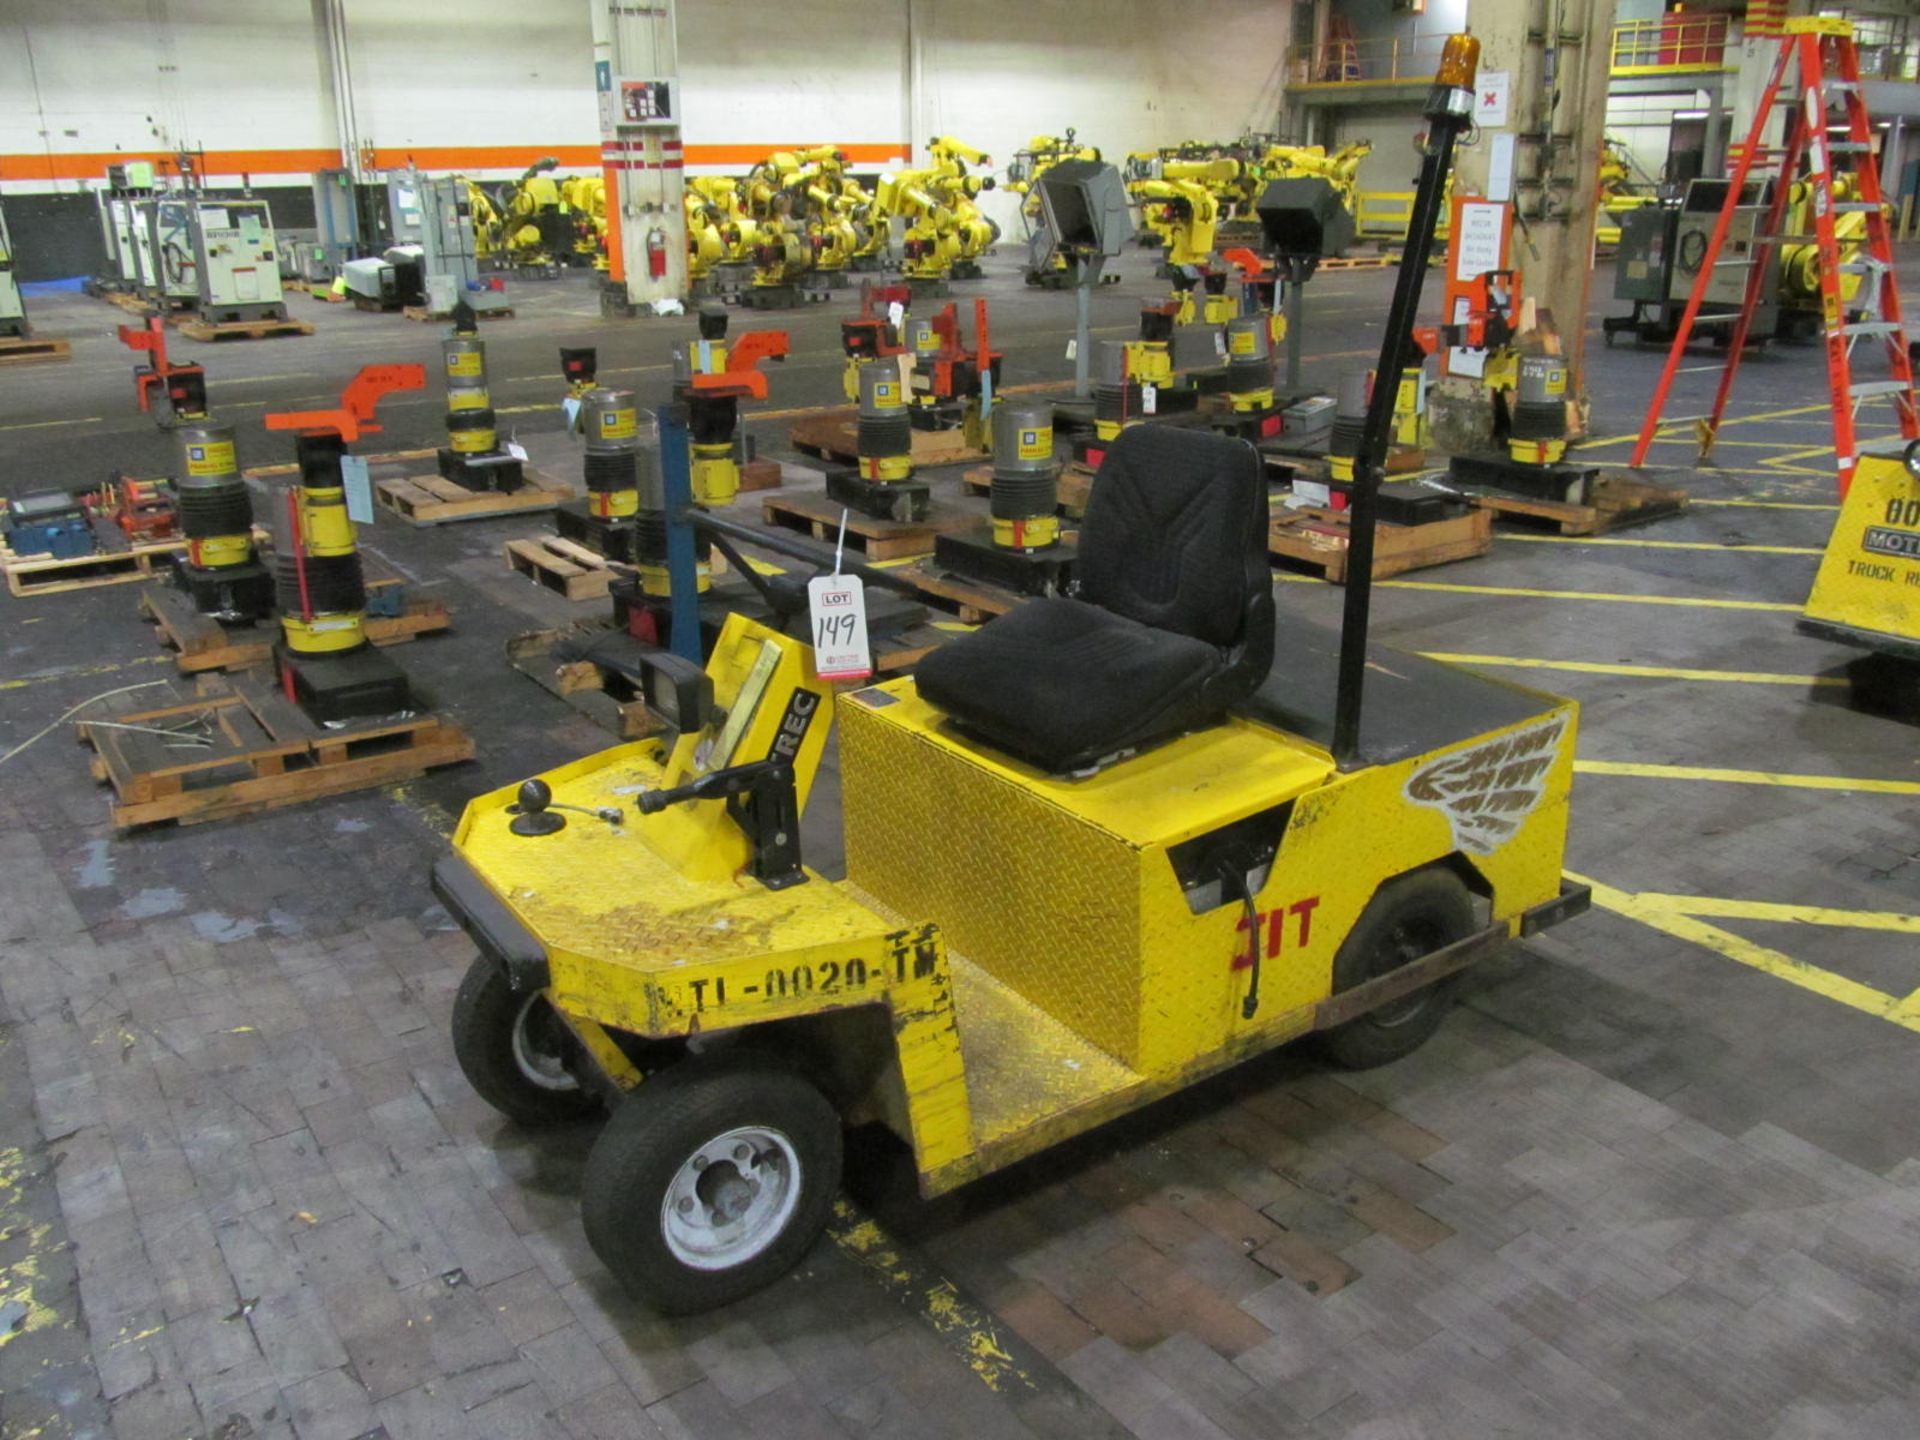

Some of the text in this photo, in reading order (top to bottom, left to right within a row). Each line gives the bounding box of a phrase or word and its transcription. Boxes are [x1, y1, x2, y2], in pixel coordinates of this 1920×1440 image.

[1868, 531, 1920, 553] MOT
[1847, 560, 1897, 582] TRUCK
[825, 594, 849, 604] LOT
[818, 613, 857, 649] 149
[771, 692, 815, 762] REC
